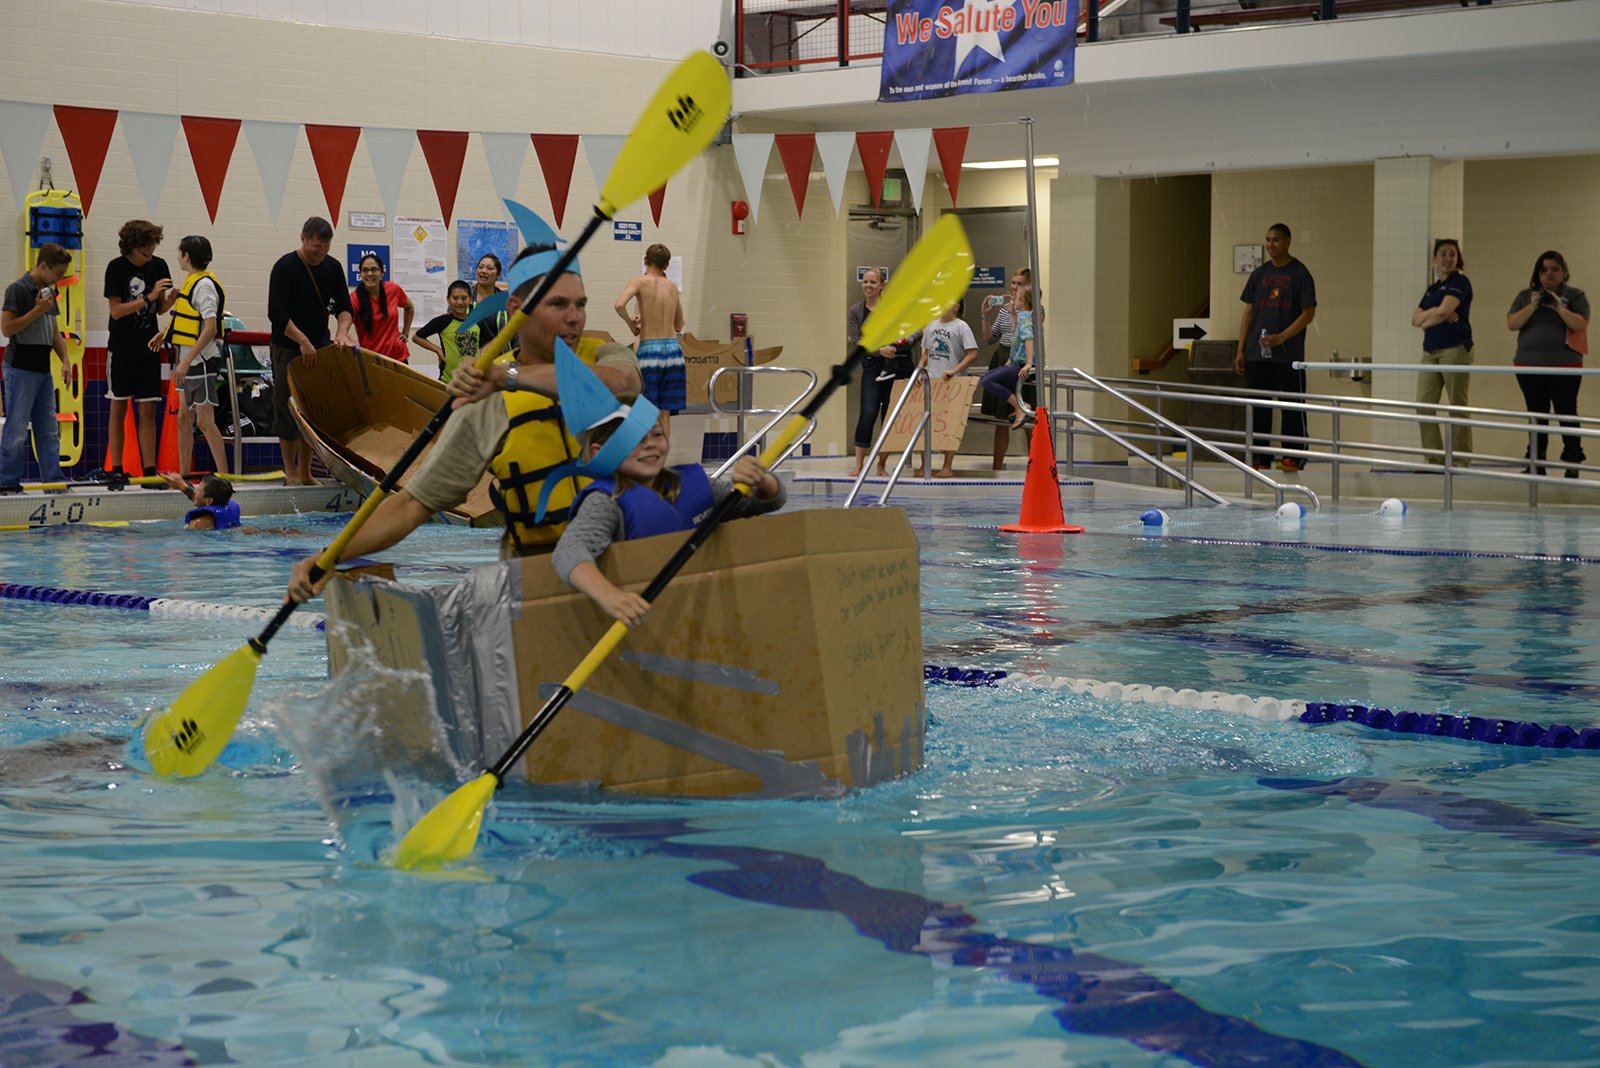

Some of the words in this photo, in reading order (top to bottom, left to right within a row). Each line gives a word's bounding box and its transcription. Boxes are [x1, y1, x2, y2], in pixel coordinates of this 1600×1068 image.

[896, 12, 932, 45] We
[935, 4, 1016, 39] Salute
[1021, 0, 1067, 29] You
[904, 85, 914, 93] men
[914, 83, 924, 92] and
[925, 82, 943, 91] women
[944, 80, 950, 89] of
[973, 77, 992, 85] Forces
[883, 178, 898, 198] EXIT
[1261, 274, 1291, 290] USC
[890, 409, 949, 435] ROCS
